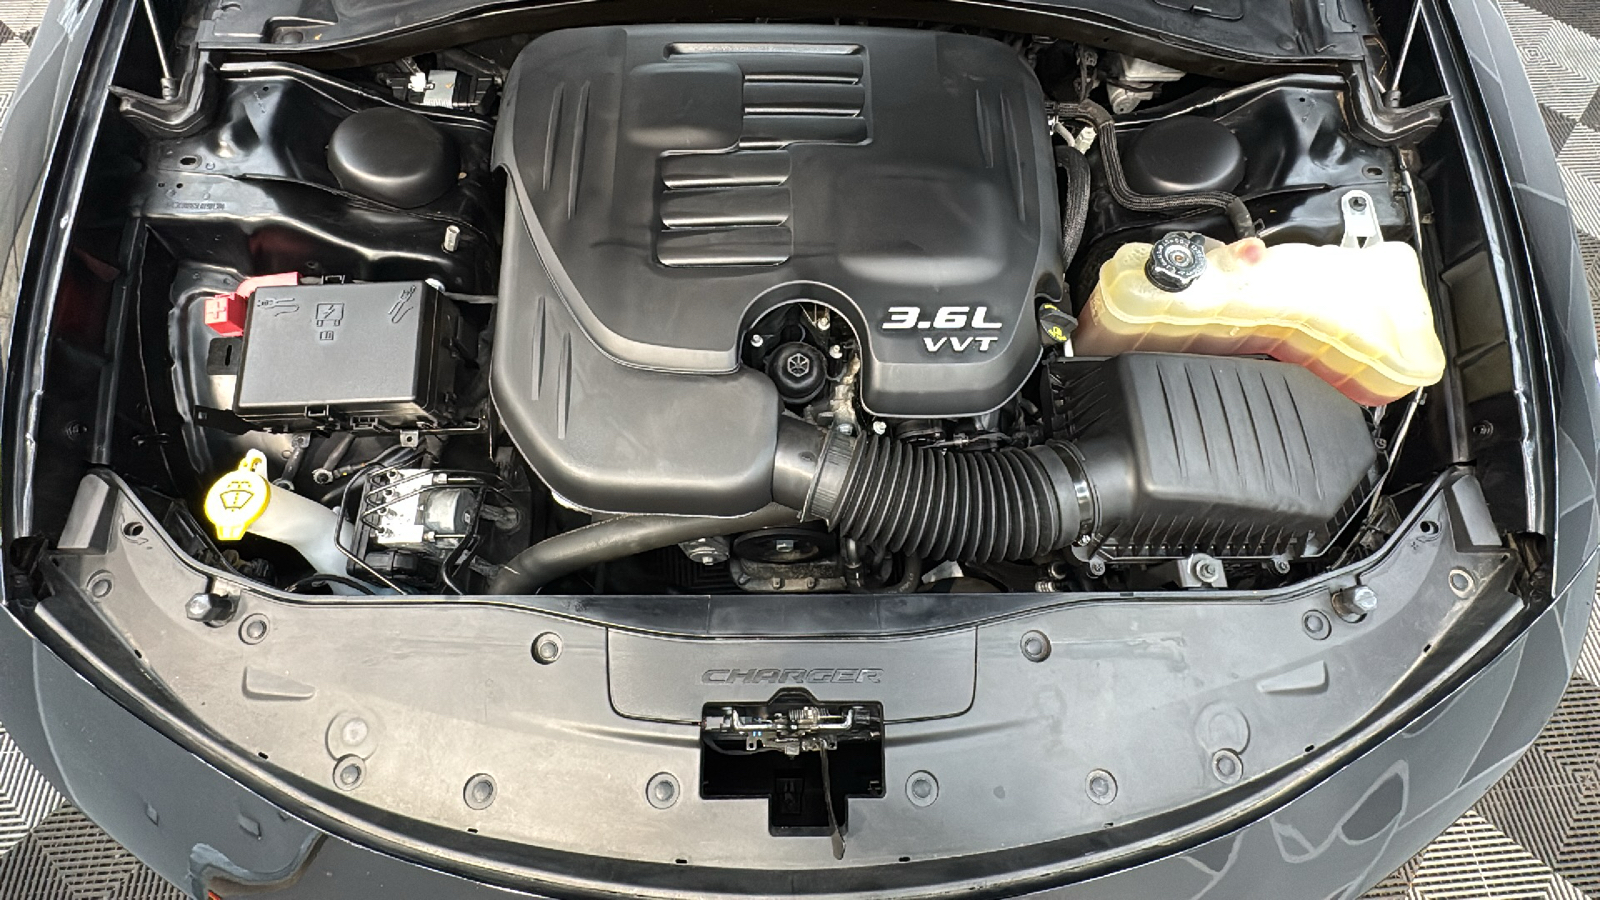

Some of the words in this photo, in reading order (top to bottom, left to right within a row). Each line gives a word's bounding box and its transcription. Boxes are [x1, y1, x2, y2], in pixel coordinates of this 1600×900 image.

[882, 306, 1003, 329] 3.6L
[923, 336, 998, 352] VVT
[701, 668, 884, 684] CHARGER
